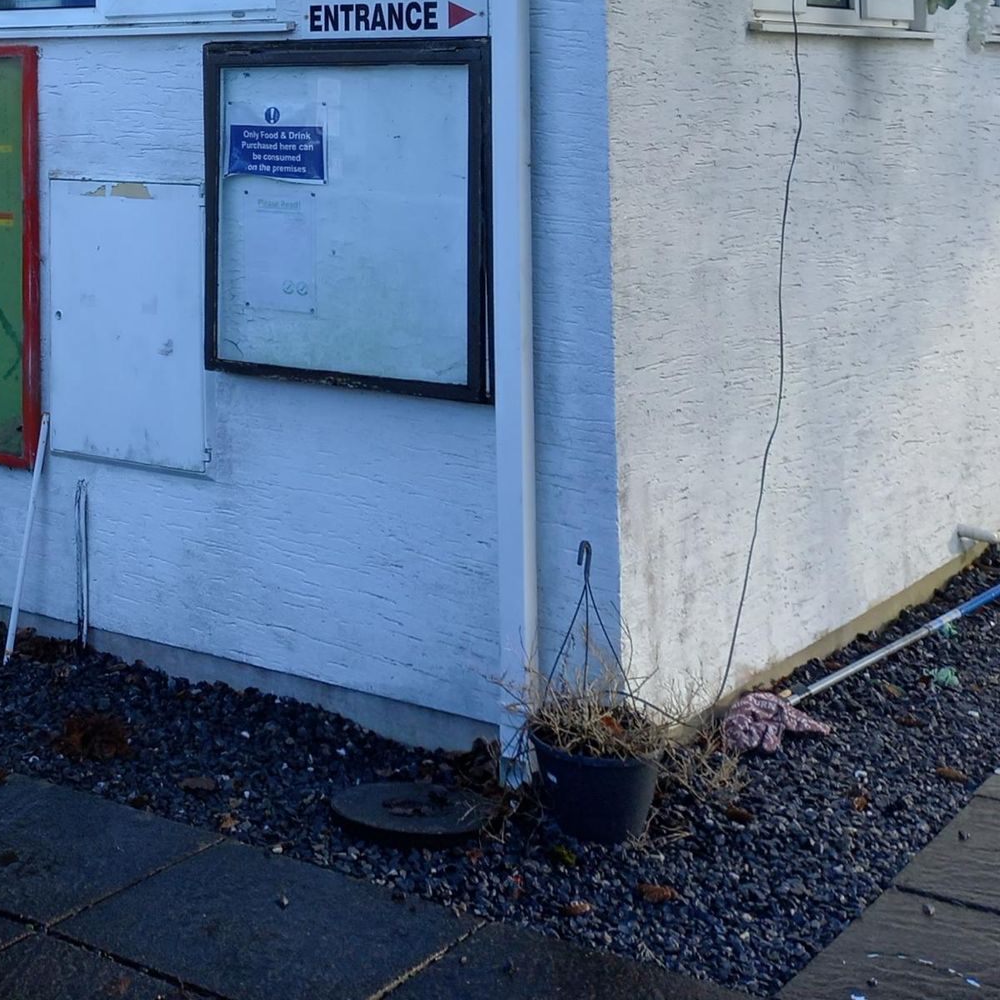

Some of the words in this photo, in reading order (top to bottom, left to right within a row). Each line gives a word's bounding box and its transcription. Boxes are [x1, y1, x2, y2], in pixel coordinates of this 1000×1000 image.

[309, 1, 438, 32] ENTRANCE
[243, 130, 259, 140] Only
[260, 130, 279, 139] Food
[281, 131, 287, 139] &
[289, 131, 311, 140] Drink
[241, 141, 278, 150] Purchased
[280, 142, 297, 151] here
[299, 143, 314, 151] can
[252, 152, 261, 160] be
[263, 153, 301, 161] consumed
[259, 164, 271, 172] the
[272, 165, 307, 174] premises
